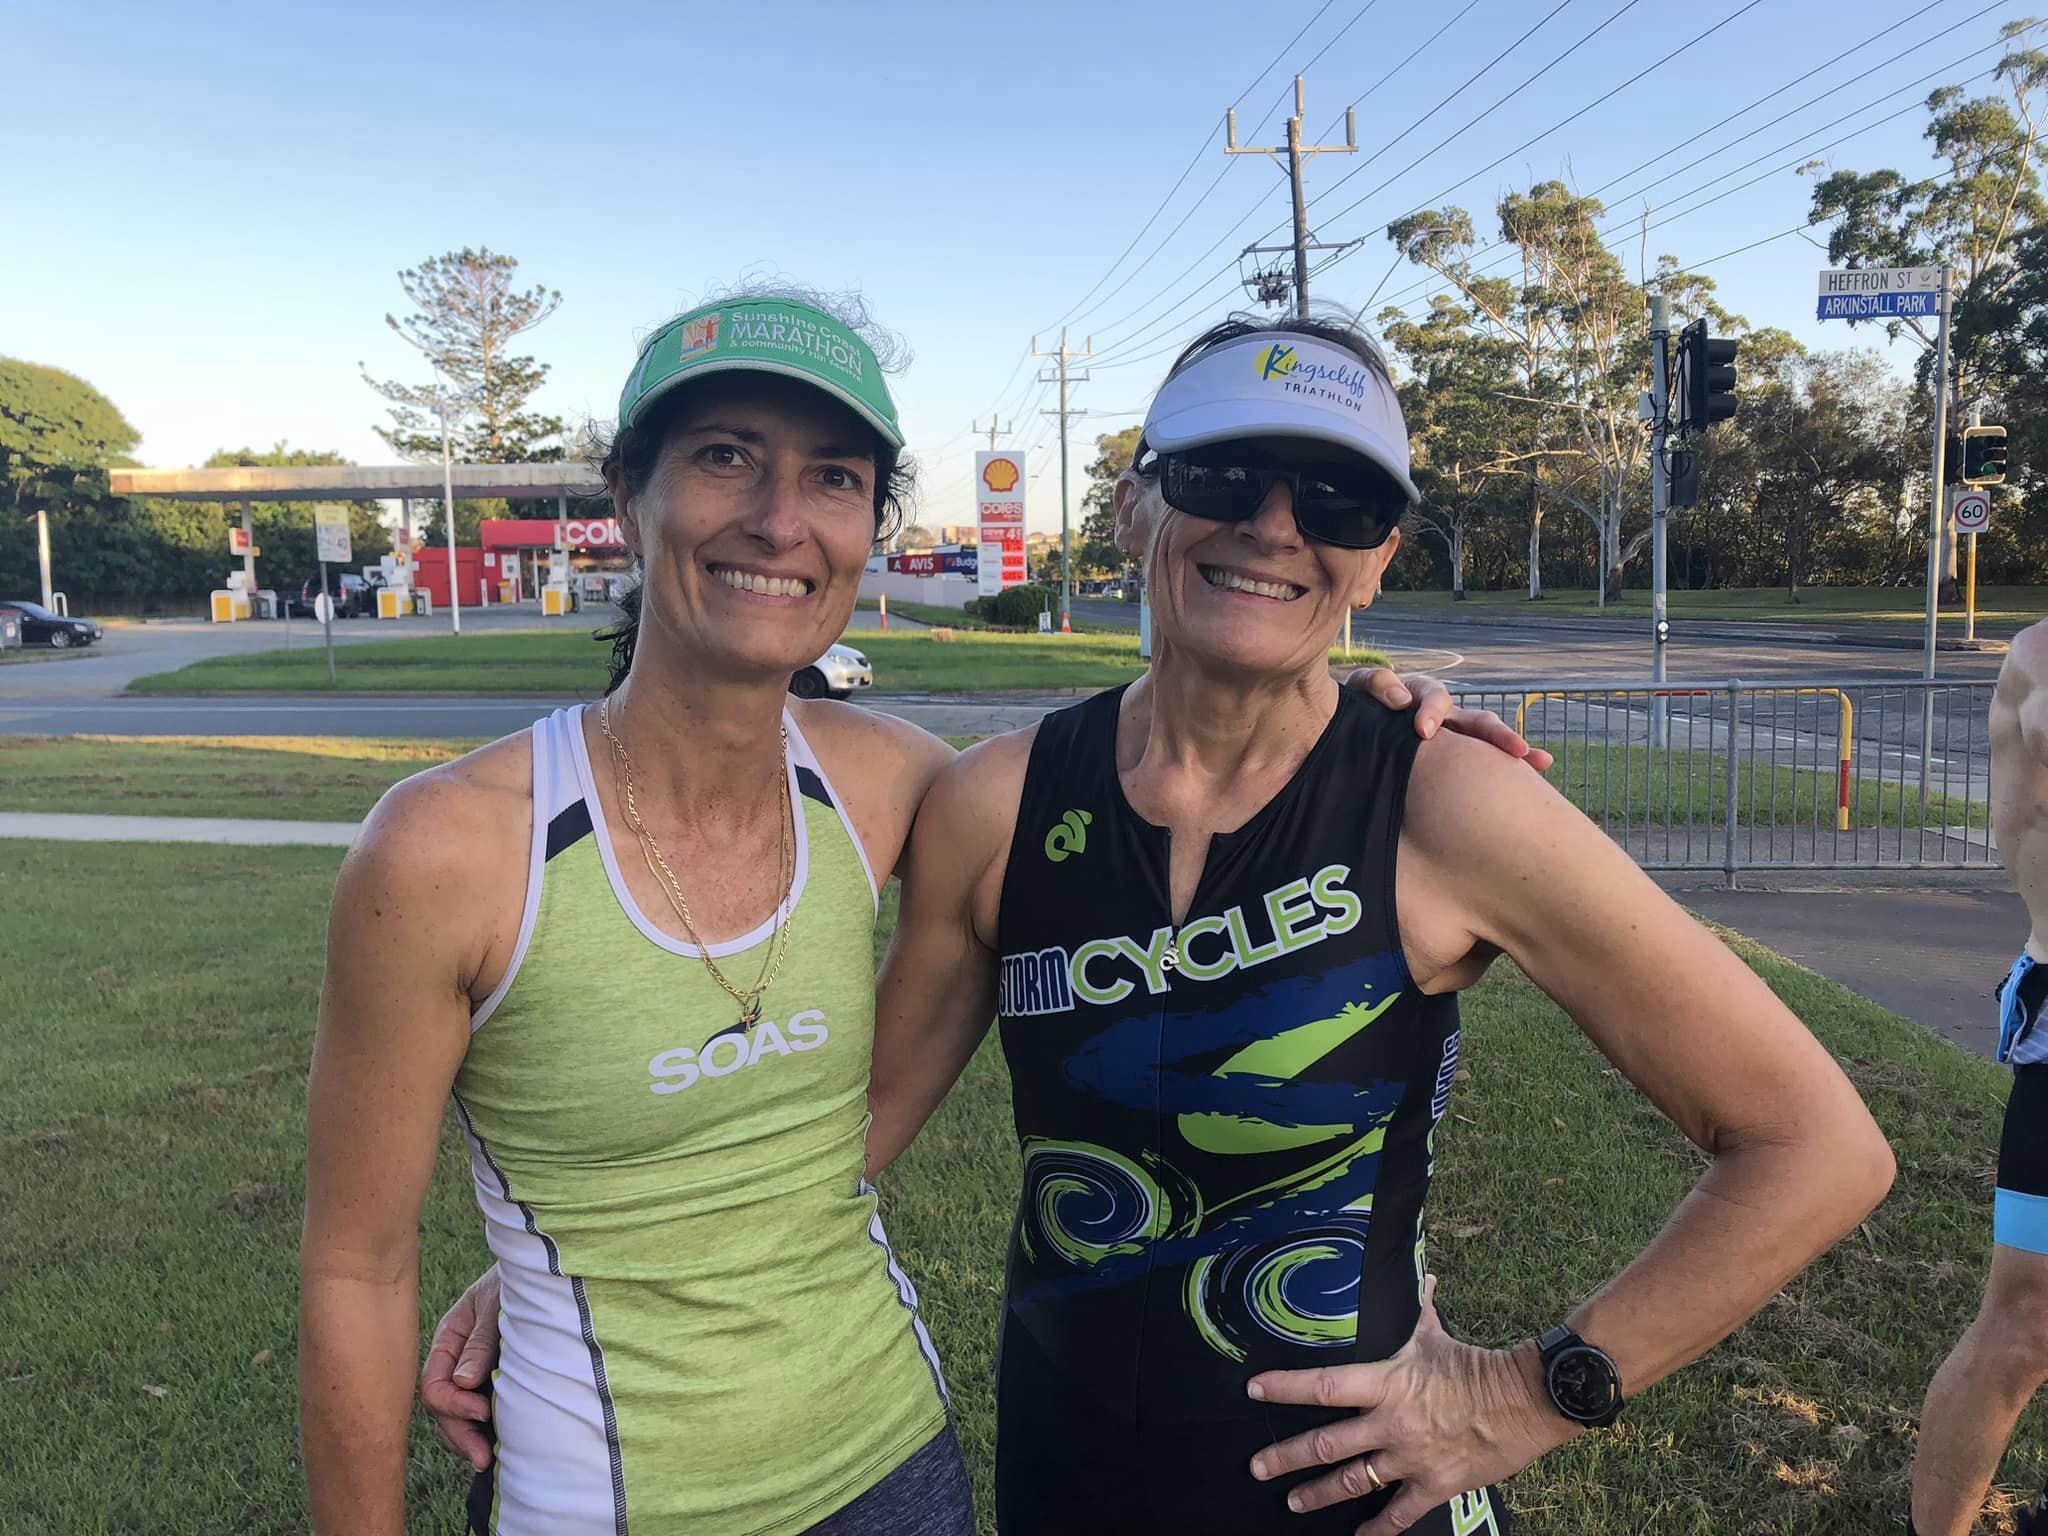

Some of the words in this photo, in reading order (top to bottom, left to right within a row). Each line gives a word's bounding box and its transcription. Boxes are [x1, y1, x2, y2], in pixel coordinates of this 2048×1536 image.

[1828, 271, 1888, 292] HEFFRON
[1897, 271, 1912, 288] ST
[1825, 295, 1893, 315] ARKINSTALL
[1897, 293, 1926, 313] PARK
[731, 311, 817, 333] Sunshine
[820, 326, 861, 358] Coast
[730, 322, 862, 375] MARATHON
[741, 339, 807, 356] community
[808, 350, 828, 363] run
[1263, 343, 1366, 398] Kingscliff
[1284, 382, 1362, 412] TRIATHLON
[982, 503, 1022, 514] coles
[1961, 504, 1982, 519] 60
[909, 557, 934, 570] AVIS
[648, 1009, 828, 1095] SOAS
